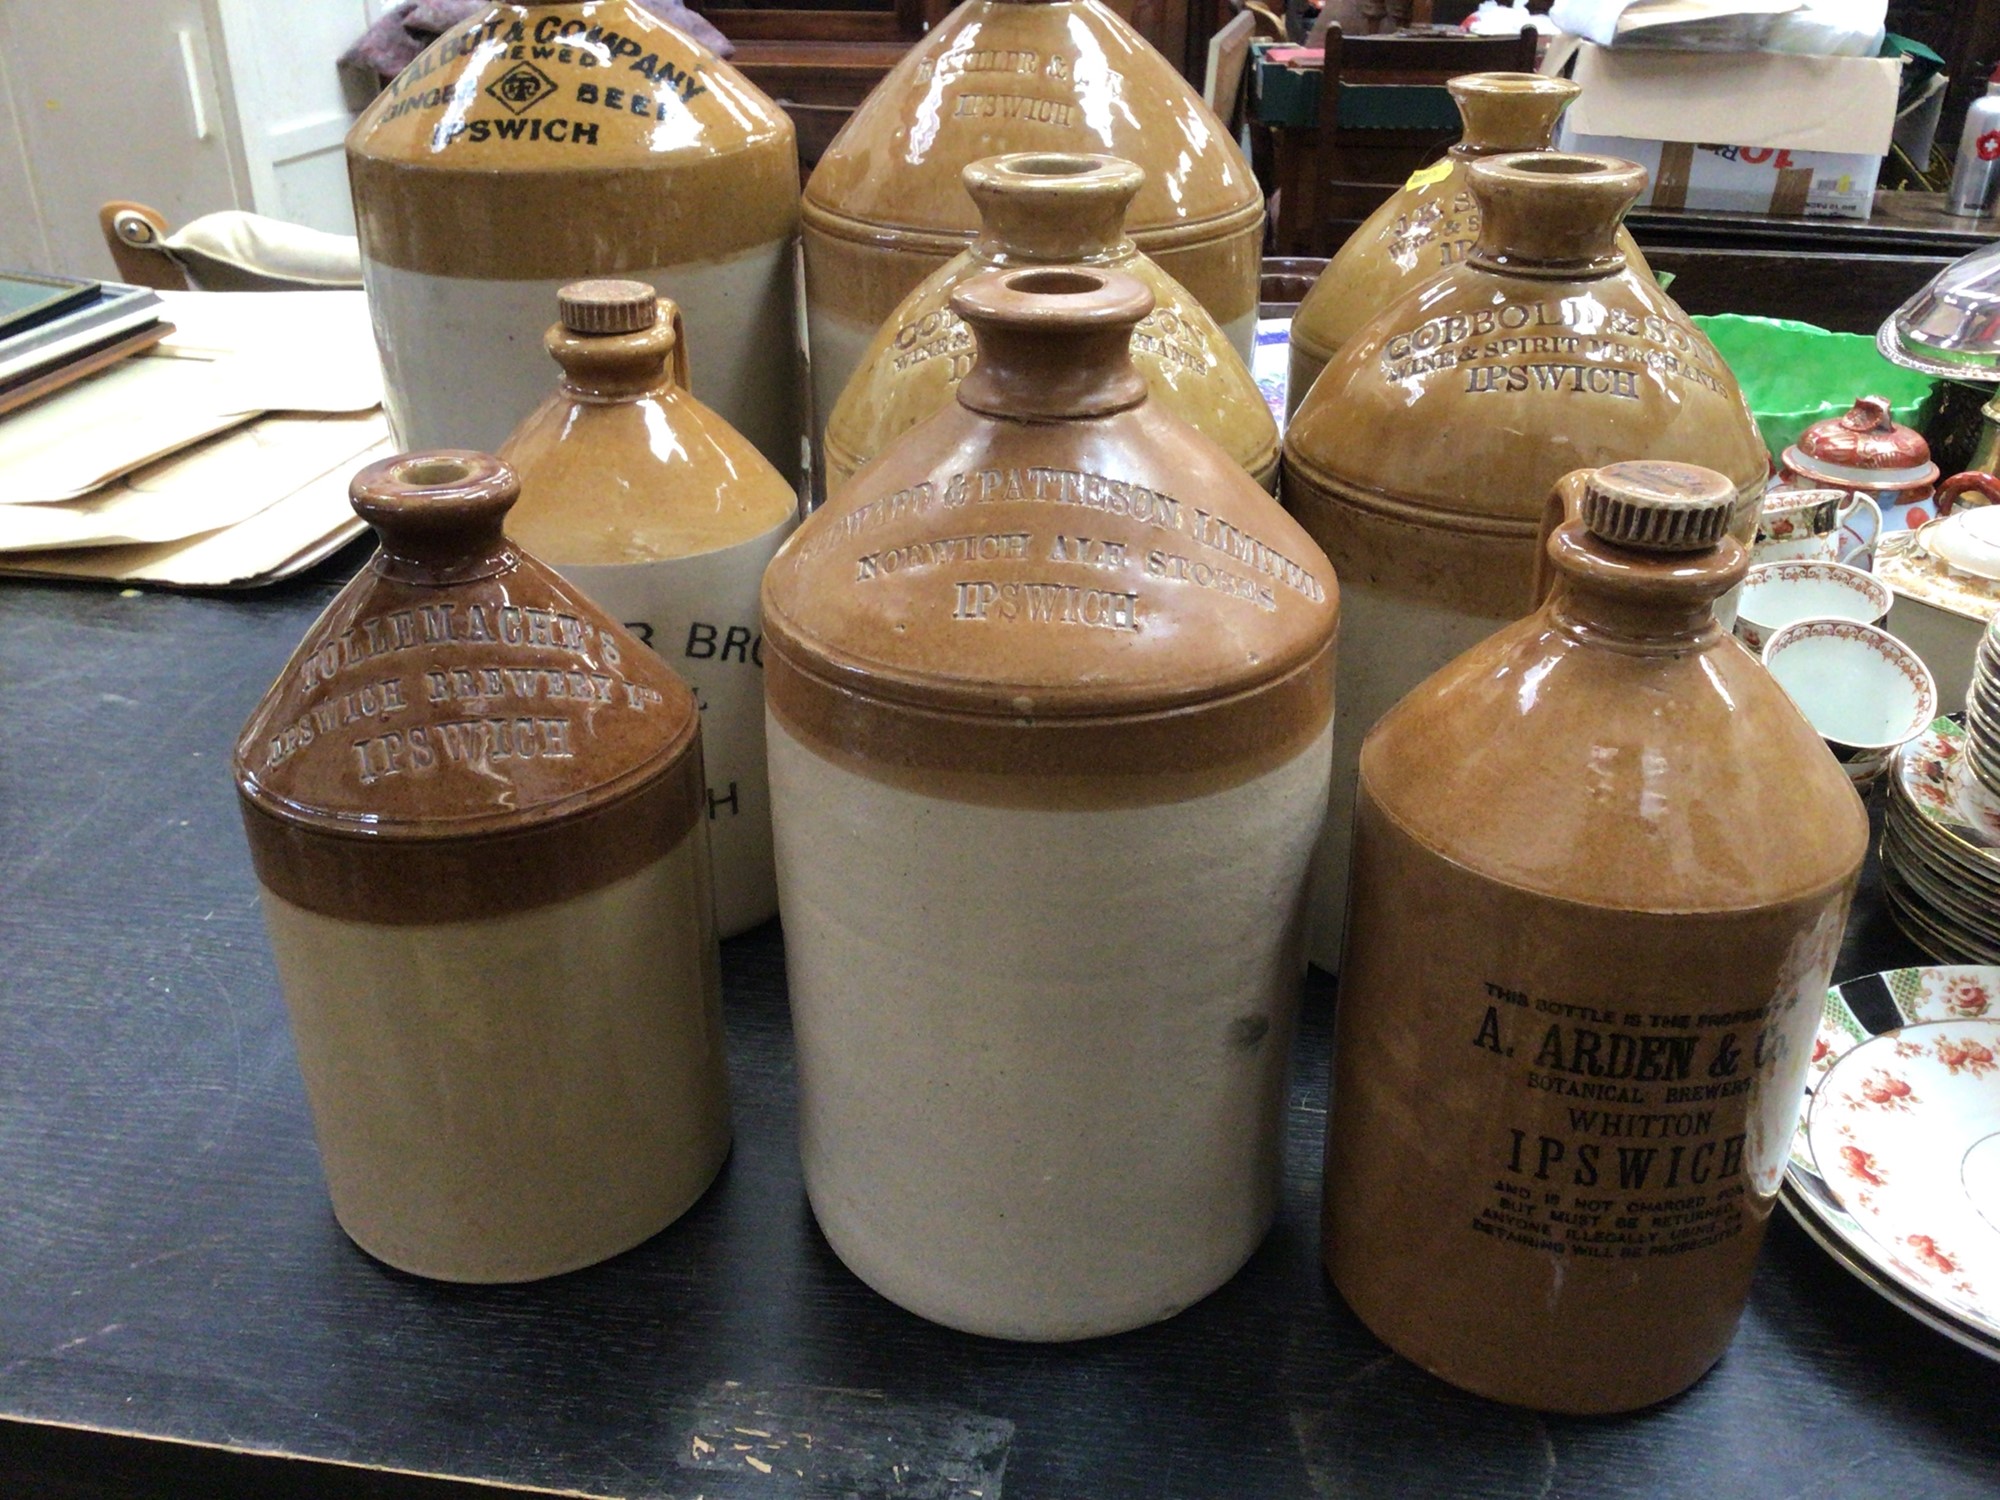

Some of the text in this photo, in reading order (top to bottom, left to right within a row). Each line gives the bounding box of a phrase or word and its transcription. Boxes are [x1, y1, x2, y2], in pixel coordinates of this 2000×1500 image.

[494, 45, 598, 68] EWED
[534, 18, 707, 103] COMPANY
[954, 94, 1074, 128] IPSWICH
[1458, 346, 1479, 362] &
[1484, 337, 1580, 358] SPIRIT
[1588, 338, 1729, 398] MERCHANTS
[1465, 365, 1639, 399] IPSWICH
[943, 474, 968, 508] &
[977, 466, 1183, 532] PATTESON
[1193, 508, 1325, 604] LIMITED
[856, 532, 1277, 612] NORWICH ALE STORES
[953, 581, 1139, 634] IPSWICH
[301, 603, 621, 692] TOLLEMACHE'S
[267, 679, 407, 767] IPSWICH
[426, 667, 613, 702] BREWERY
[351, 717, 574, 785] IPSWICH
[1536, 999, 1616, 1025] BOTTLE
[1624, 1014, 1642, 1027] IS
[1650, 1015, 1692, 1029] THE
[1473, 1006, 1514, 1058] A.
[1534, 1023, 1701, 1083] ARDEN
[1708, 1032, 1742, 1078] &
[1528, 1072, 1645, 1103] BOTANICAL
[1568, 1108, 1715, 1139] WHITTON
[1507, 1128, 1747, 1190] IPSWICH
[1494, 1180, 1530, 1200] AND
[1575, 1198, 1614, 1212] NOT
[1626, 1196, 1706, 1213] CHARGED
[1500, 1197, 1536, 1216] BUT
[1550, 1210, 1600, 1227] MUST
[1615, 1217, 1638, 1229] BE
[1482, 1208, 1552, 1236] ANYONE
[1565, 1228, 1658, 1244] ILLEGALLY
